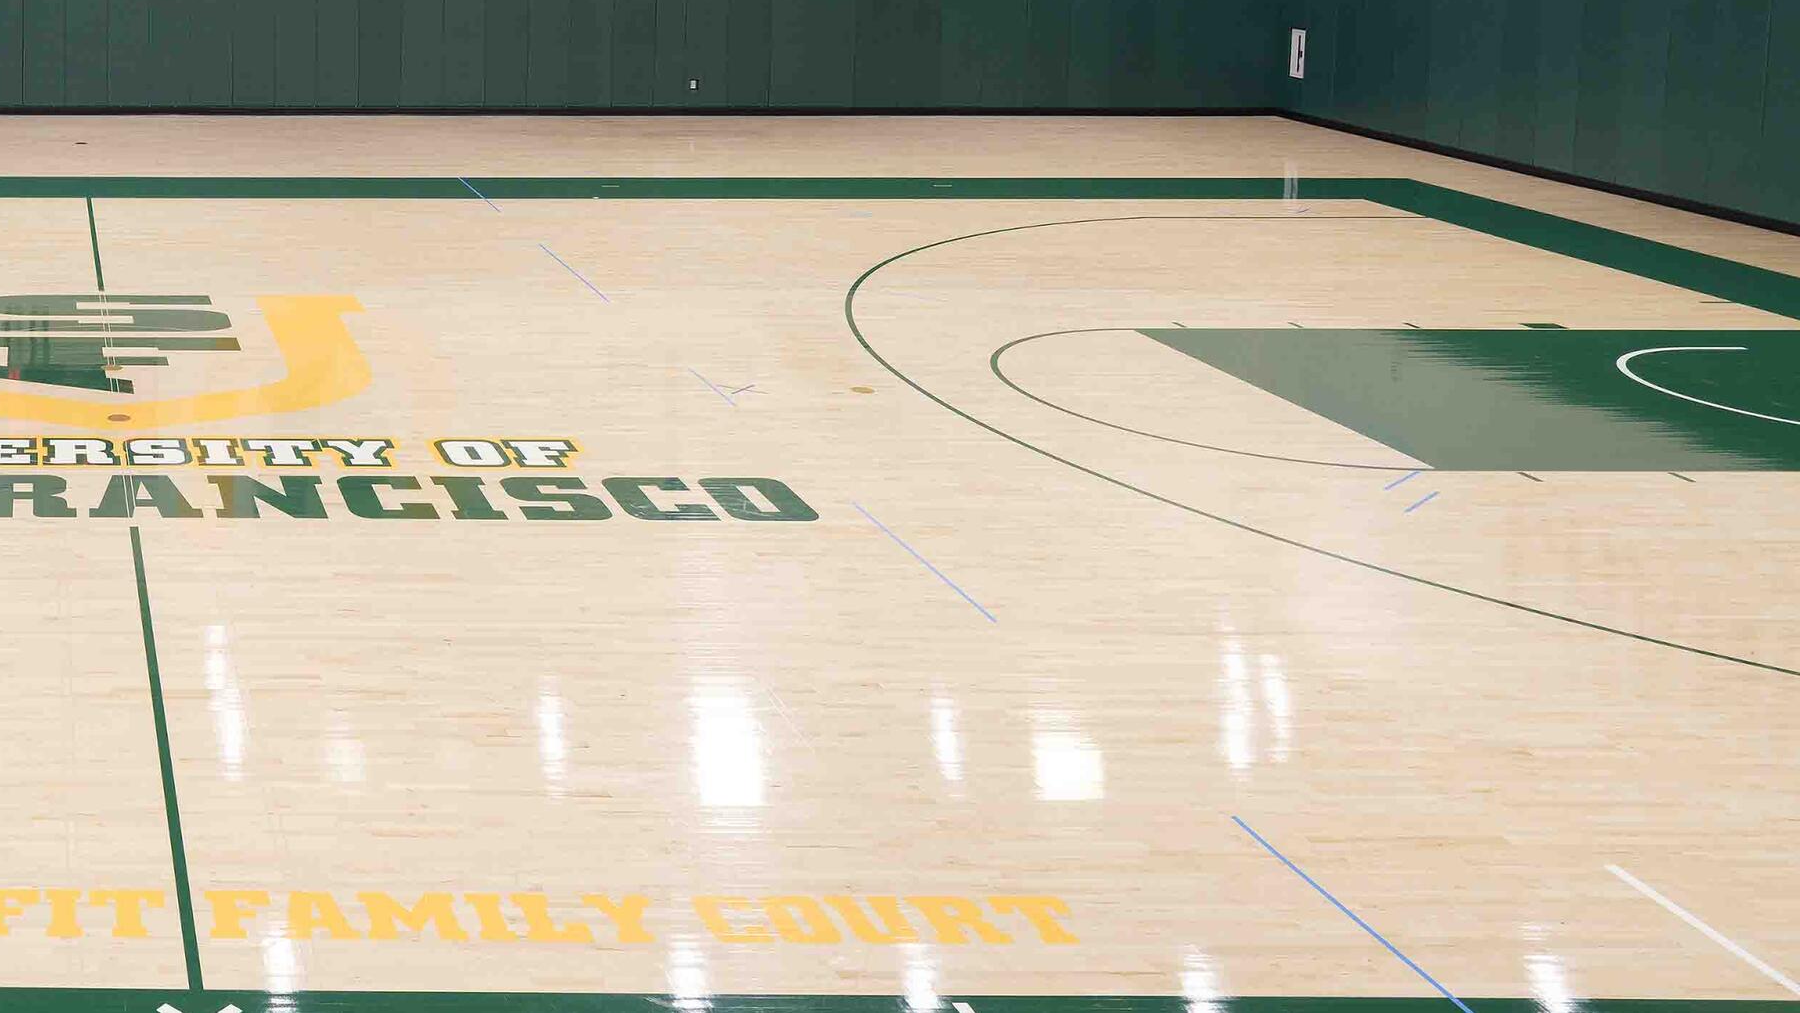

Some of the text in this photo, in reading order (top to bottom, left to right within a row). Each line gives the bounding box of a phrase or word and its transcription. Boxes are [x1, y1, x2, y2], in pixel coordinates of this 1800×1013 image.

[431, 437, 583, 469] OF
[203, 889, 655, 943] FAMILY
[693, 894, 1082, 946] COURT
